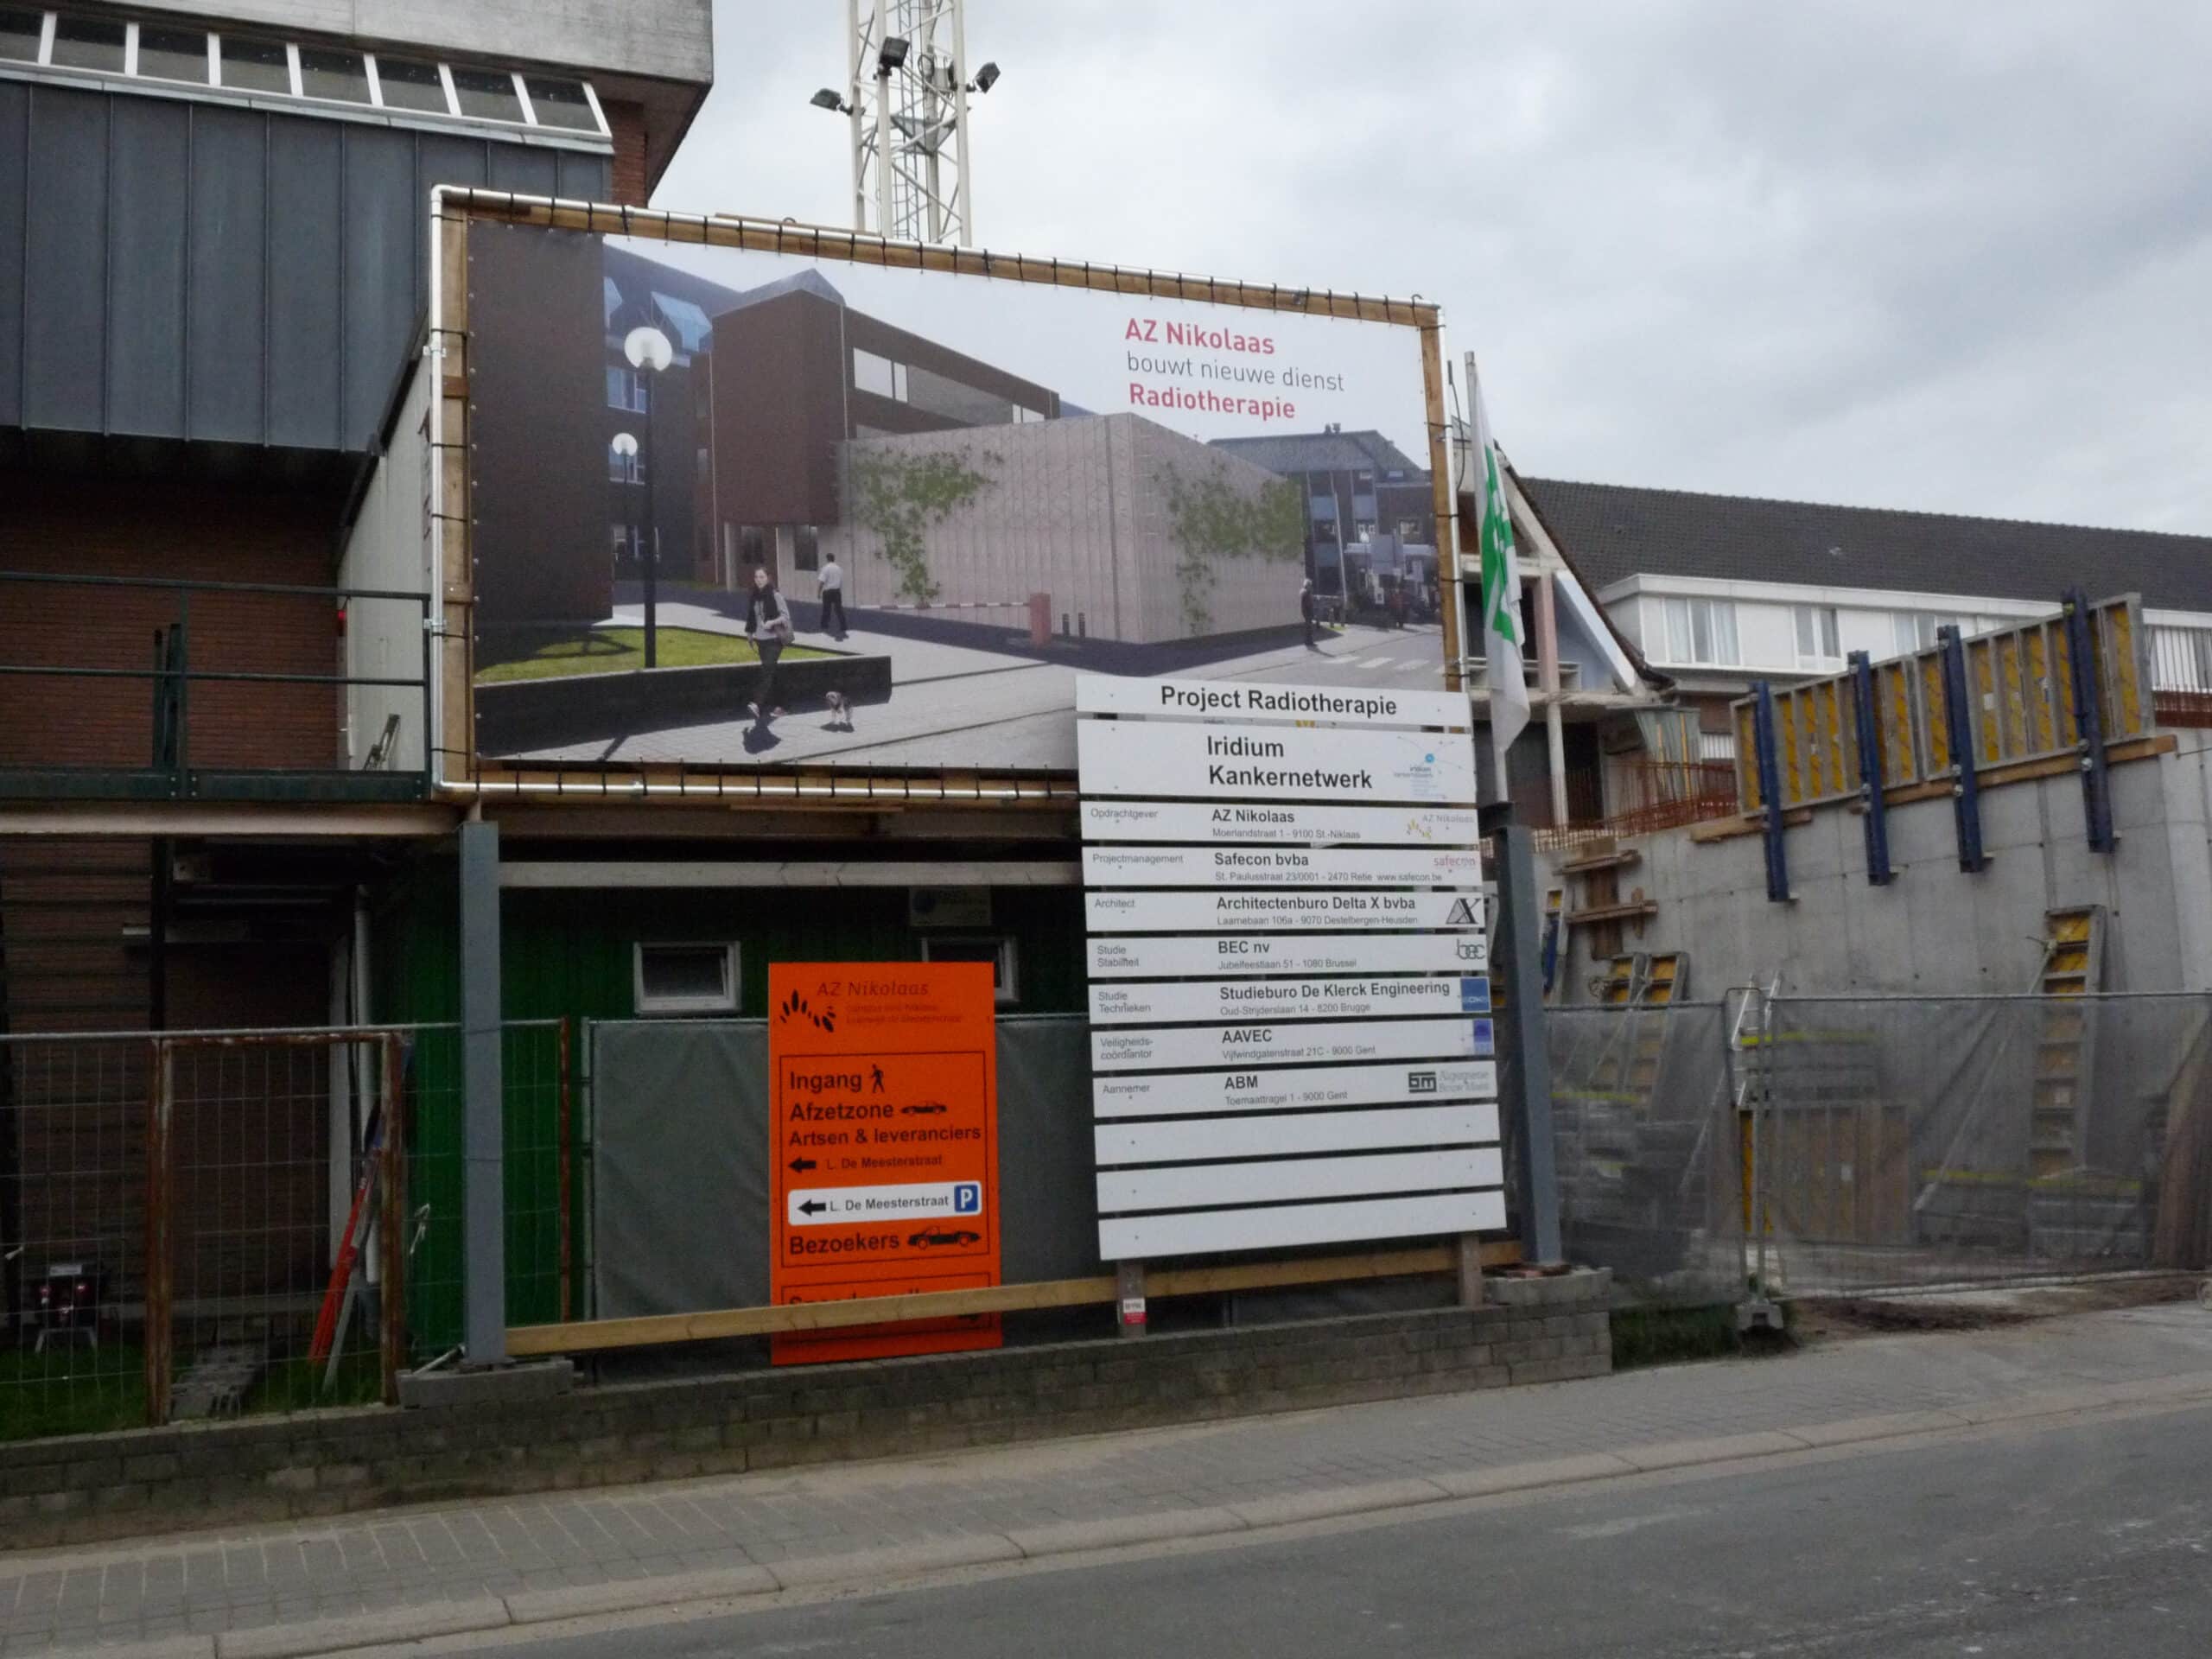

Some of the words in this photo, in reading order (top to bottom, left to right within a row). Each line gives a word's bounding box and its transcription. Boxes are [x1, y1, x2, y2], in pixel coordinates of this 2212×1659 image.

[1125, 318, 1158, 342] AZ
[1166, 321, 1274, 354] Nikolaas
[1128, 352, 1192, 377] bouwt
[1201, 362, 1274, 385] nieuwe
[1282, 367, 1344, 391] dienst
[1129, 384, 1295, 421] Radiotherapie
[1160, 686, 1241, 710] Project
[1248, 691, 1397, 717] Radiotherapie
[1207, 736, 1284, 758] Iridium
[1209, 766, 1372, 789] Kankernetwerk
[1090, 809, 1158, 819] Opdrachtgever
[1212, 809, 1231, 822] AZ
[1236, 810, 1294, 823] Nikolaas
[1213, 829, 1276, 837] Moerlandstraat
[1093, 854, 1183, 864] Projectmanagement
[1214, 853, 1270, 866] Safecon
[1276, 854, 1309, 866] bvba
[1230, 872, 1283, 881] Paulusstraat
[1328, 872, 1349, 880] 2470
[1095, 899, 1135, 907] Architect
[1217, 897, 1328, 910] Architectenburo
[1332, 896, 1366, 909] Delta
[1370, 897, 1380, 909] X
[1384, 897, 1415, 909] bvba
[1272, 916, 1293, 925] 106a
[1301, 916, 1321, 925] 9070
[1097, 945, 1126, 955] Studie
[1218, 941, 1249, 954] BEC
[1254, 943, 1269, 953] nv
[1325, 959, 1357, 968] Brussel
[817, 982, 842, 995] AZ
[848, 981, 929, 995] Nikolaas
[1220, 986, 1297, 1000] Studieburo
[1302, 985, 1319, 997] De
[1324, 983, 1367, 997] Klerck
[1371, 982, 1450, 998] Engineering
[1098, 992, 1128, 1001] Studie
[1099, 1002, 1151, 1013] Technieken
[1317, 1003, 1338, 1012] 8200
[1340, 1003, 1370, 1013] Brugge
[1100, 1037, 1154, 1048] Veiligheids-
[1222, 1030, 1272, 1043] AAVEC
[1223, 1047, 1305, 1061] Vijfwindgatenstraat
[1332, 1046, 1353, 1055] 9000
[1355, 1046, 1376, 1054] Gent
[790, 1071, 861, 1093] Ingang
[1103, 1084, 1150, 1094] Aannemer
[1224, 1076, 1258, 1090] ABM
[1303, 1092, 1325, 1101] 9000
[1327, 1091, 1348, 1100] Gent
[790, 1102, 894, 1121] Afzetzone
[789, 1131, 849, 1147] Artsen
[855, 1129, 868, 1143] &
[874, 1125, 981, 1142] leveranciers
[827, 1157, 836, 1169] L.
[842, 1157, 857, 1168] De
[861, 1155, 943, 1168] Meesterstraat
[830, 1200, 841, 1211] L.
[846, 1199, 861, 1211] De
[866, 1195, 950, 1210] Meesterstraat
[960, 1189, 973, 1209] P
[790, 1232, 899, 1255] Bezoekers
